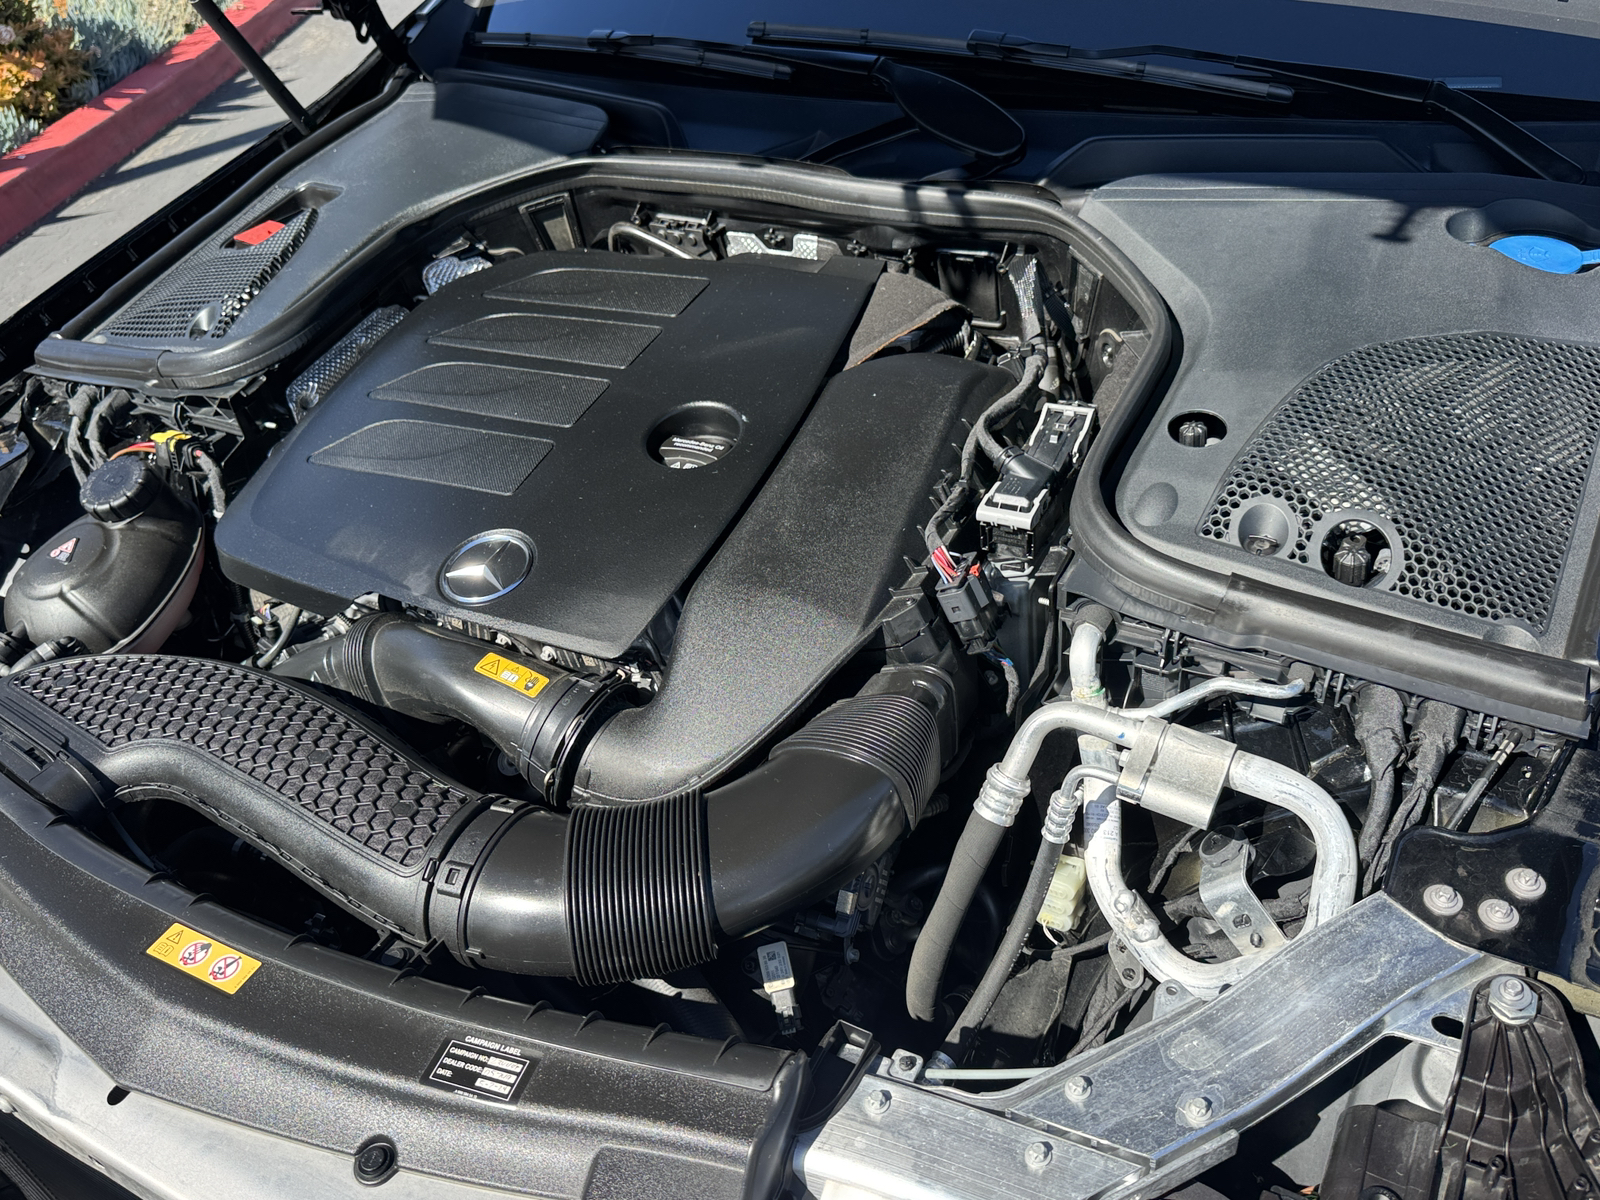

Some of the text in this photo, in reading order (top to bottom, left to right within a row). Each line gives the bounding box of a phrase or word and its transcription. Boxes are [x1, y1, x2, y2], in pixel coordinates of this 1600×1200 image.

[672, 437, 715, 448] Mercedes-Benz
[465, 1035, 522, 1056] CAMPAIGN LABEL
[449, 1047, 480, 1060] CAMPAIGN
[442, 1057, 465, 1069] DEALER
[464, 1063, 483, 1074] CODE:
[436, 1067, 453, 1078] DATE:
